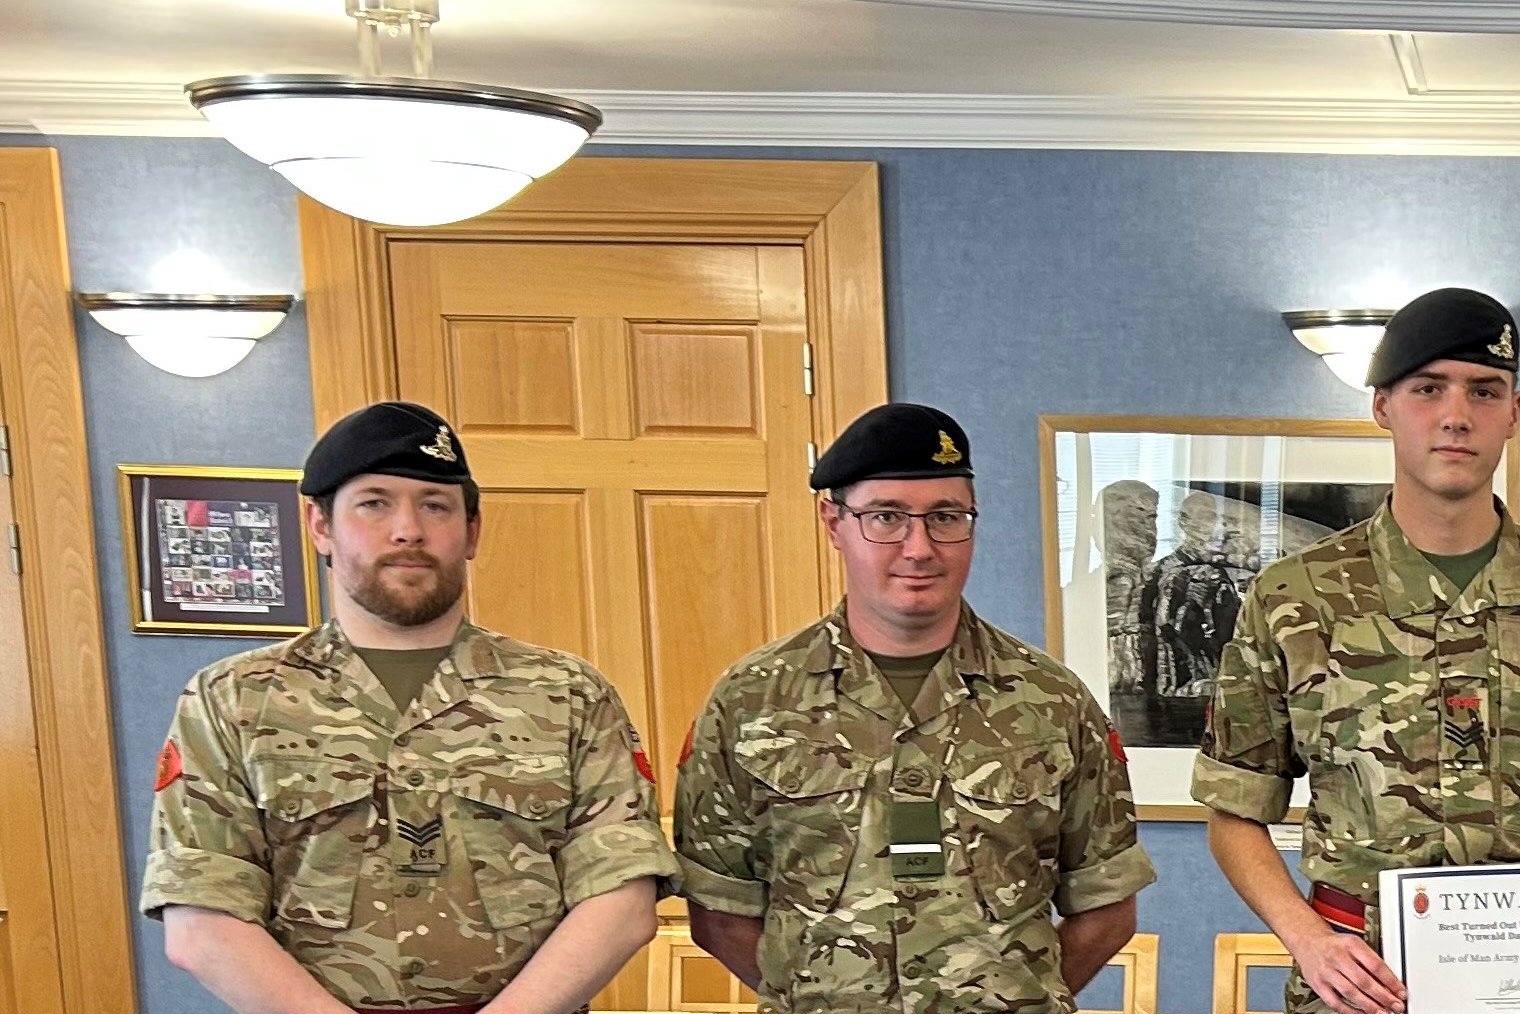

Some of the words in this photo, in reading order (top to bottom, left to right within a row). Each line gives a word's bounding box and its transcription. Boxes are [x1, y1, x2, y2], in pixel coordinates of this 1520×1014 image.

[410, 849, 436, 860] ACF
[906, 856, 929, 866] ACF
[1438, 922, 1459, 931] Best
[1461, 921, 1498, 931] Turned
[1499, 920, 1517, 930] Out
[1463, 931, 1506, 943] Tynwald
[1438, 954, 1456, 964] Isle
[1457, 953, 1470, 963] of
[1470, 953, 1492, 963] Man
[1493, 952, 1520, 964] Army
